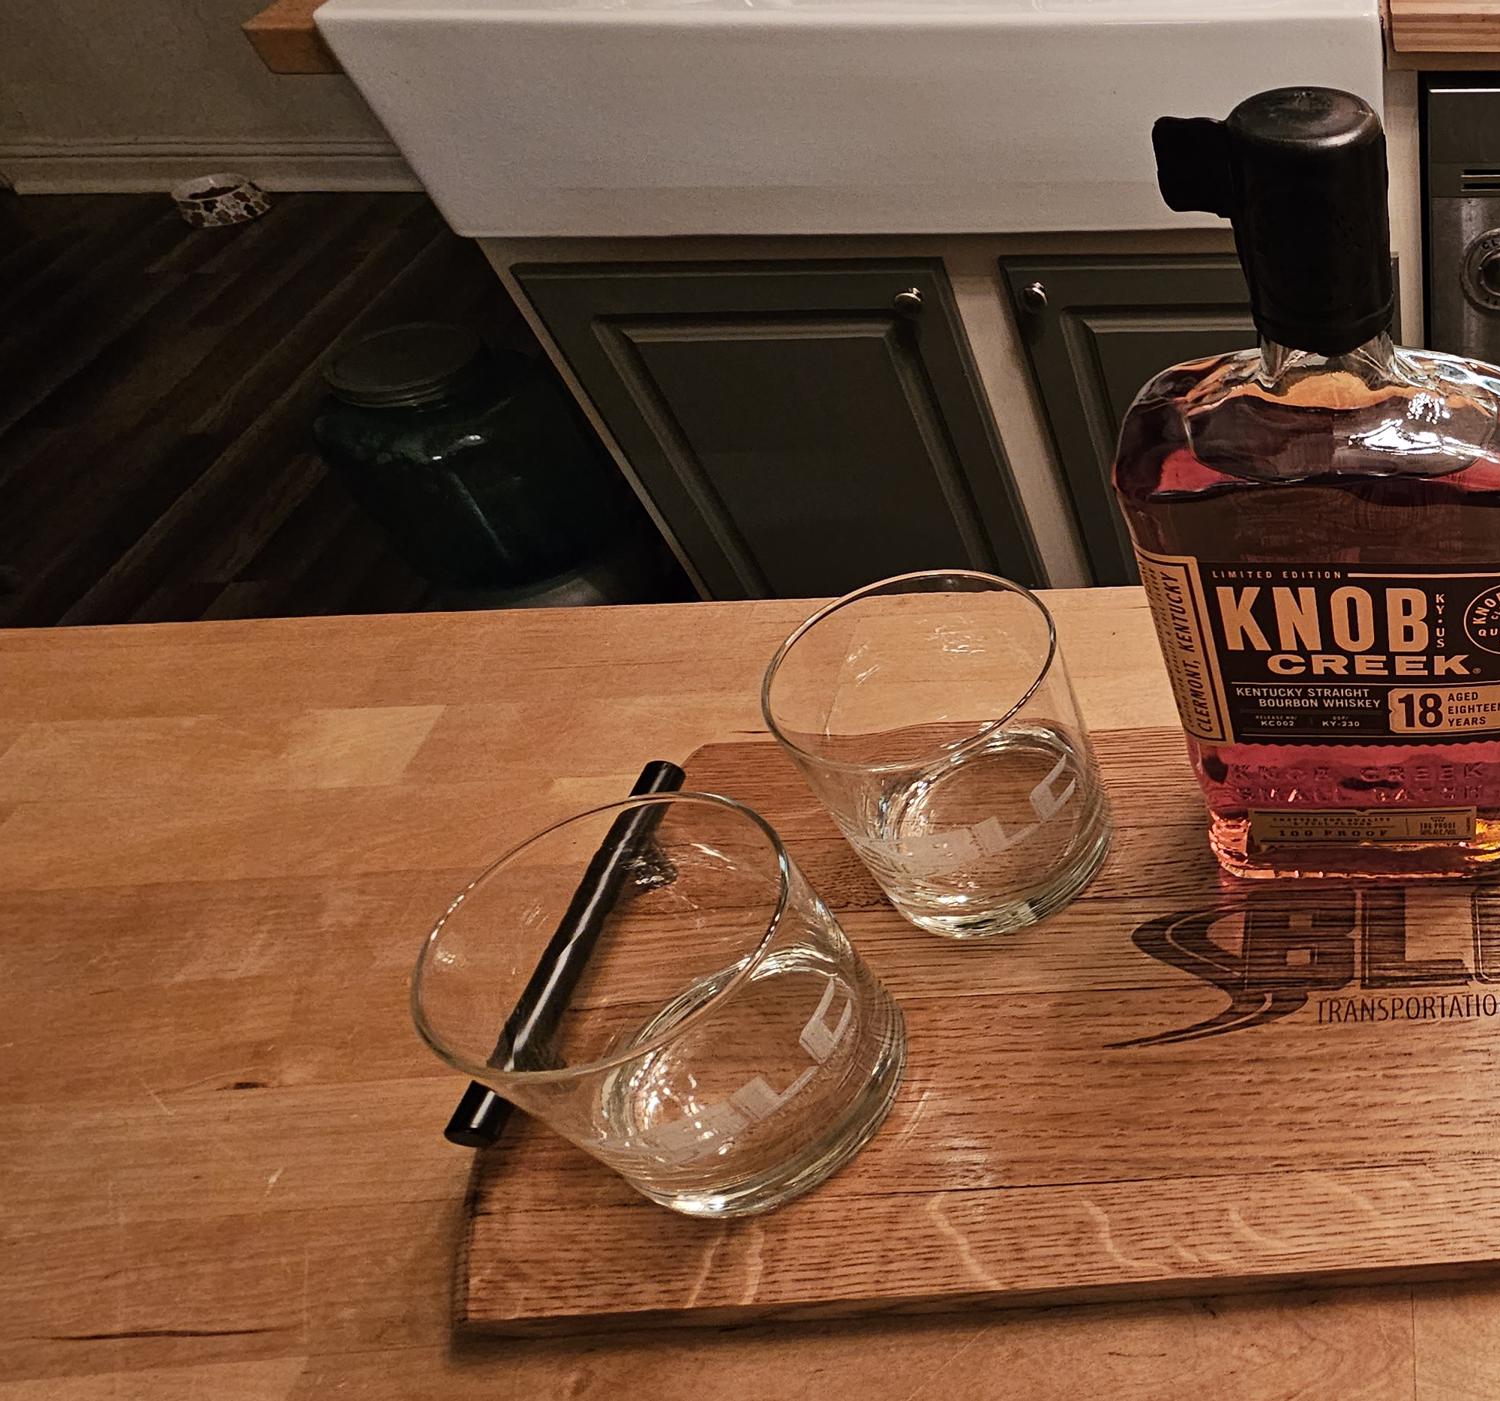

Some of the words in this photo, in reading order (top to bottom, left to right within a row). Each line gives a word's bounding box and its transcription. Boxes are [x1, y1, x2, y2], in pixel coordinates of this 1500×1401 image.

[1212, 570, 1273, 579] LIMITED
[1282, 570, 1342, 579] EDITION
[1160, 571, 1196, 653] KENTUCKY
[1216, 585, 1429, 653] KNOB
[1267, 653, 1470, 676] CREEK
[1183, 659, 1214, 733] CLERMONT,
[1236, 687, 1303, 697] KENTUCKY
[1307, 687, 1370, 697] STRAIGHT
[1447, 691, 1479, 702] AGED
[1258, 698, 1319, 708] BOURBON
[1322, 698, 1381, 708] WHISKEY
[1397, 693, 1444, 729] 18
[1447, 716, 1487, 727] YEARS
[1360, 762, 1483, 782] CREEK
[1279, 829, 1314, 837] 100
[1323, 829, 1389, 837] PROOF
